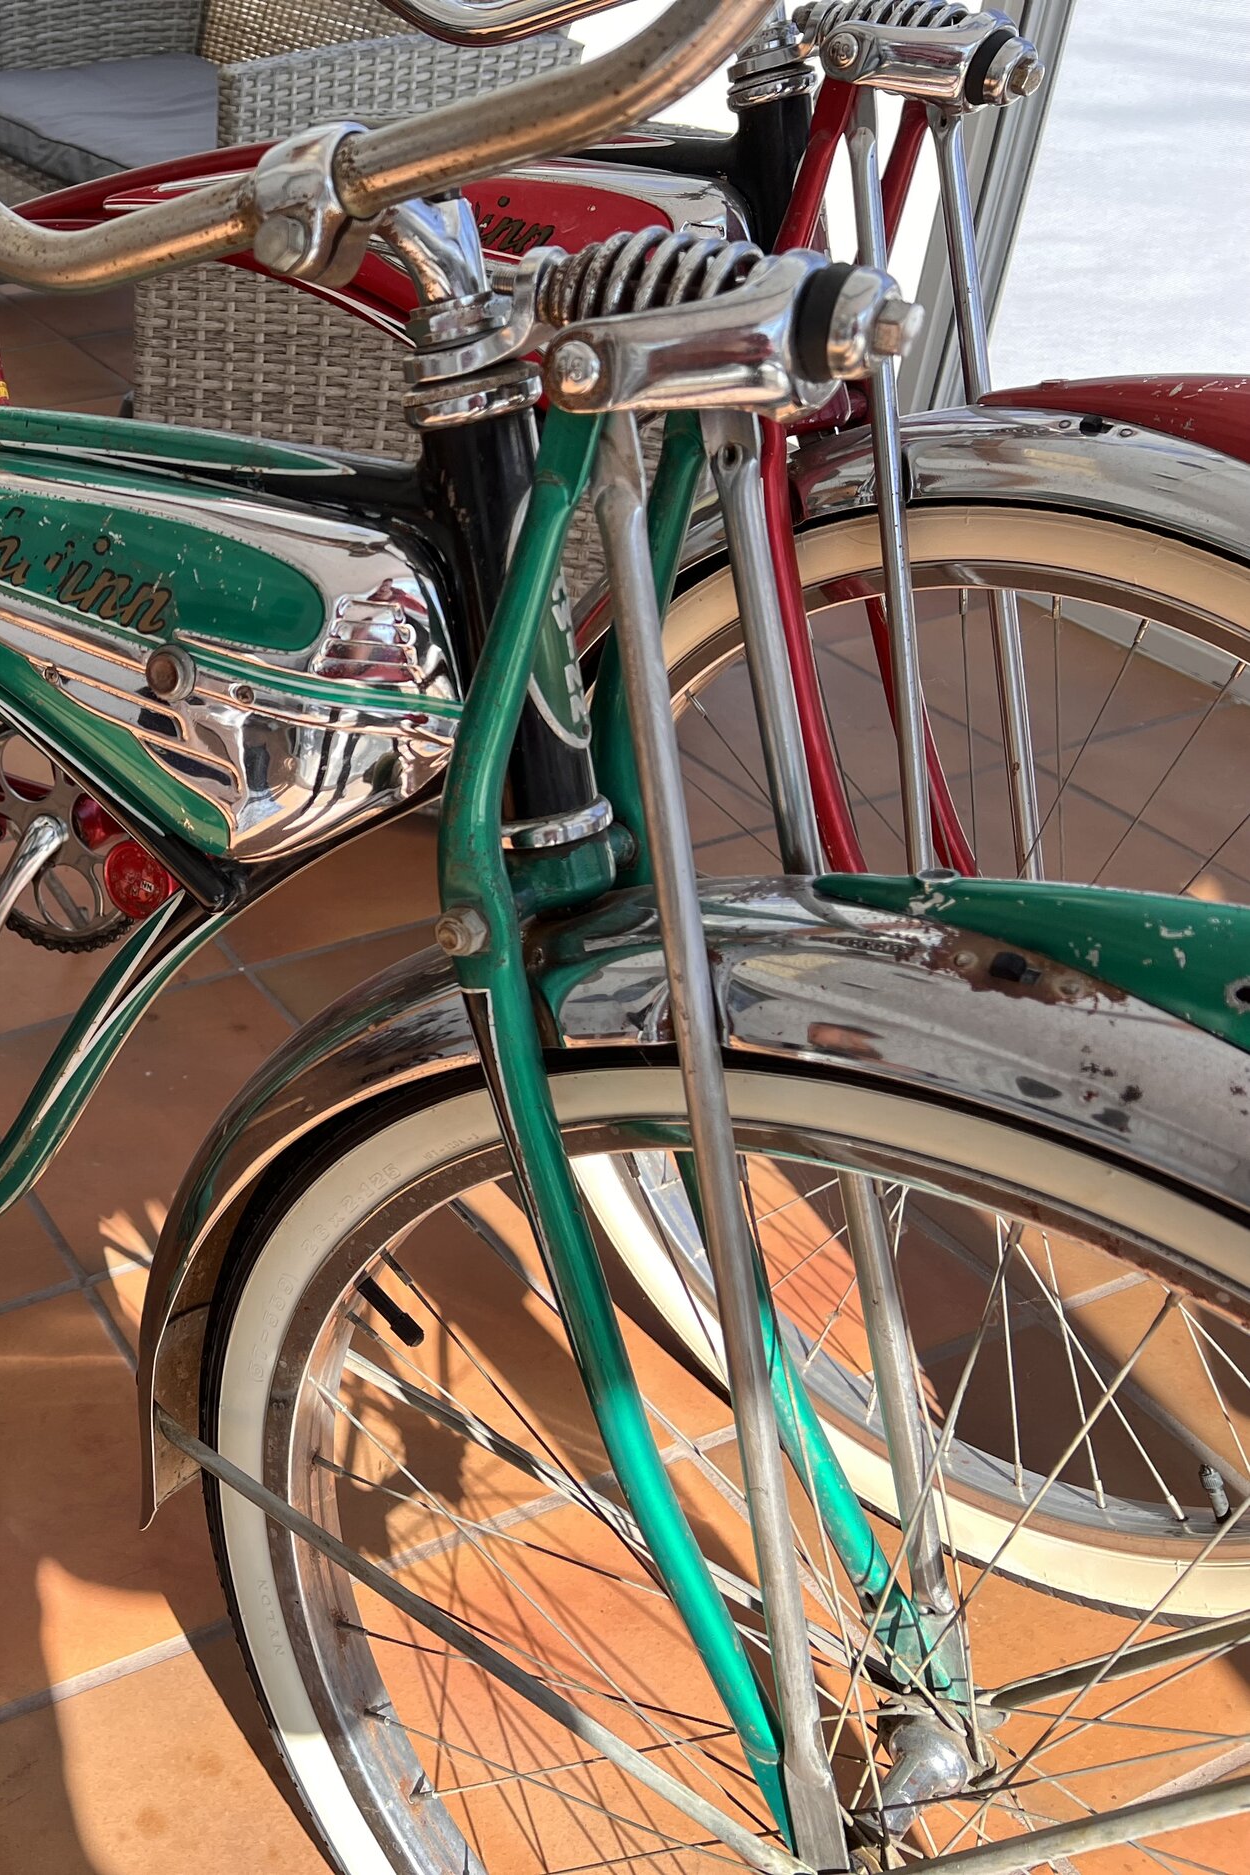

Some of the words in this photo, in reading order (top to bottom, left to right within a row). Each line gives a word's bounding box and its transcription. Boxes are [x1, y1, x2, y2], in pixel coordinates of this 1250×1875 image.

[300, 1224, 331, 1258] 26
[341, 1162, 402, 1215] 2.125
[257, 1579, 286, 1657] NYLON
